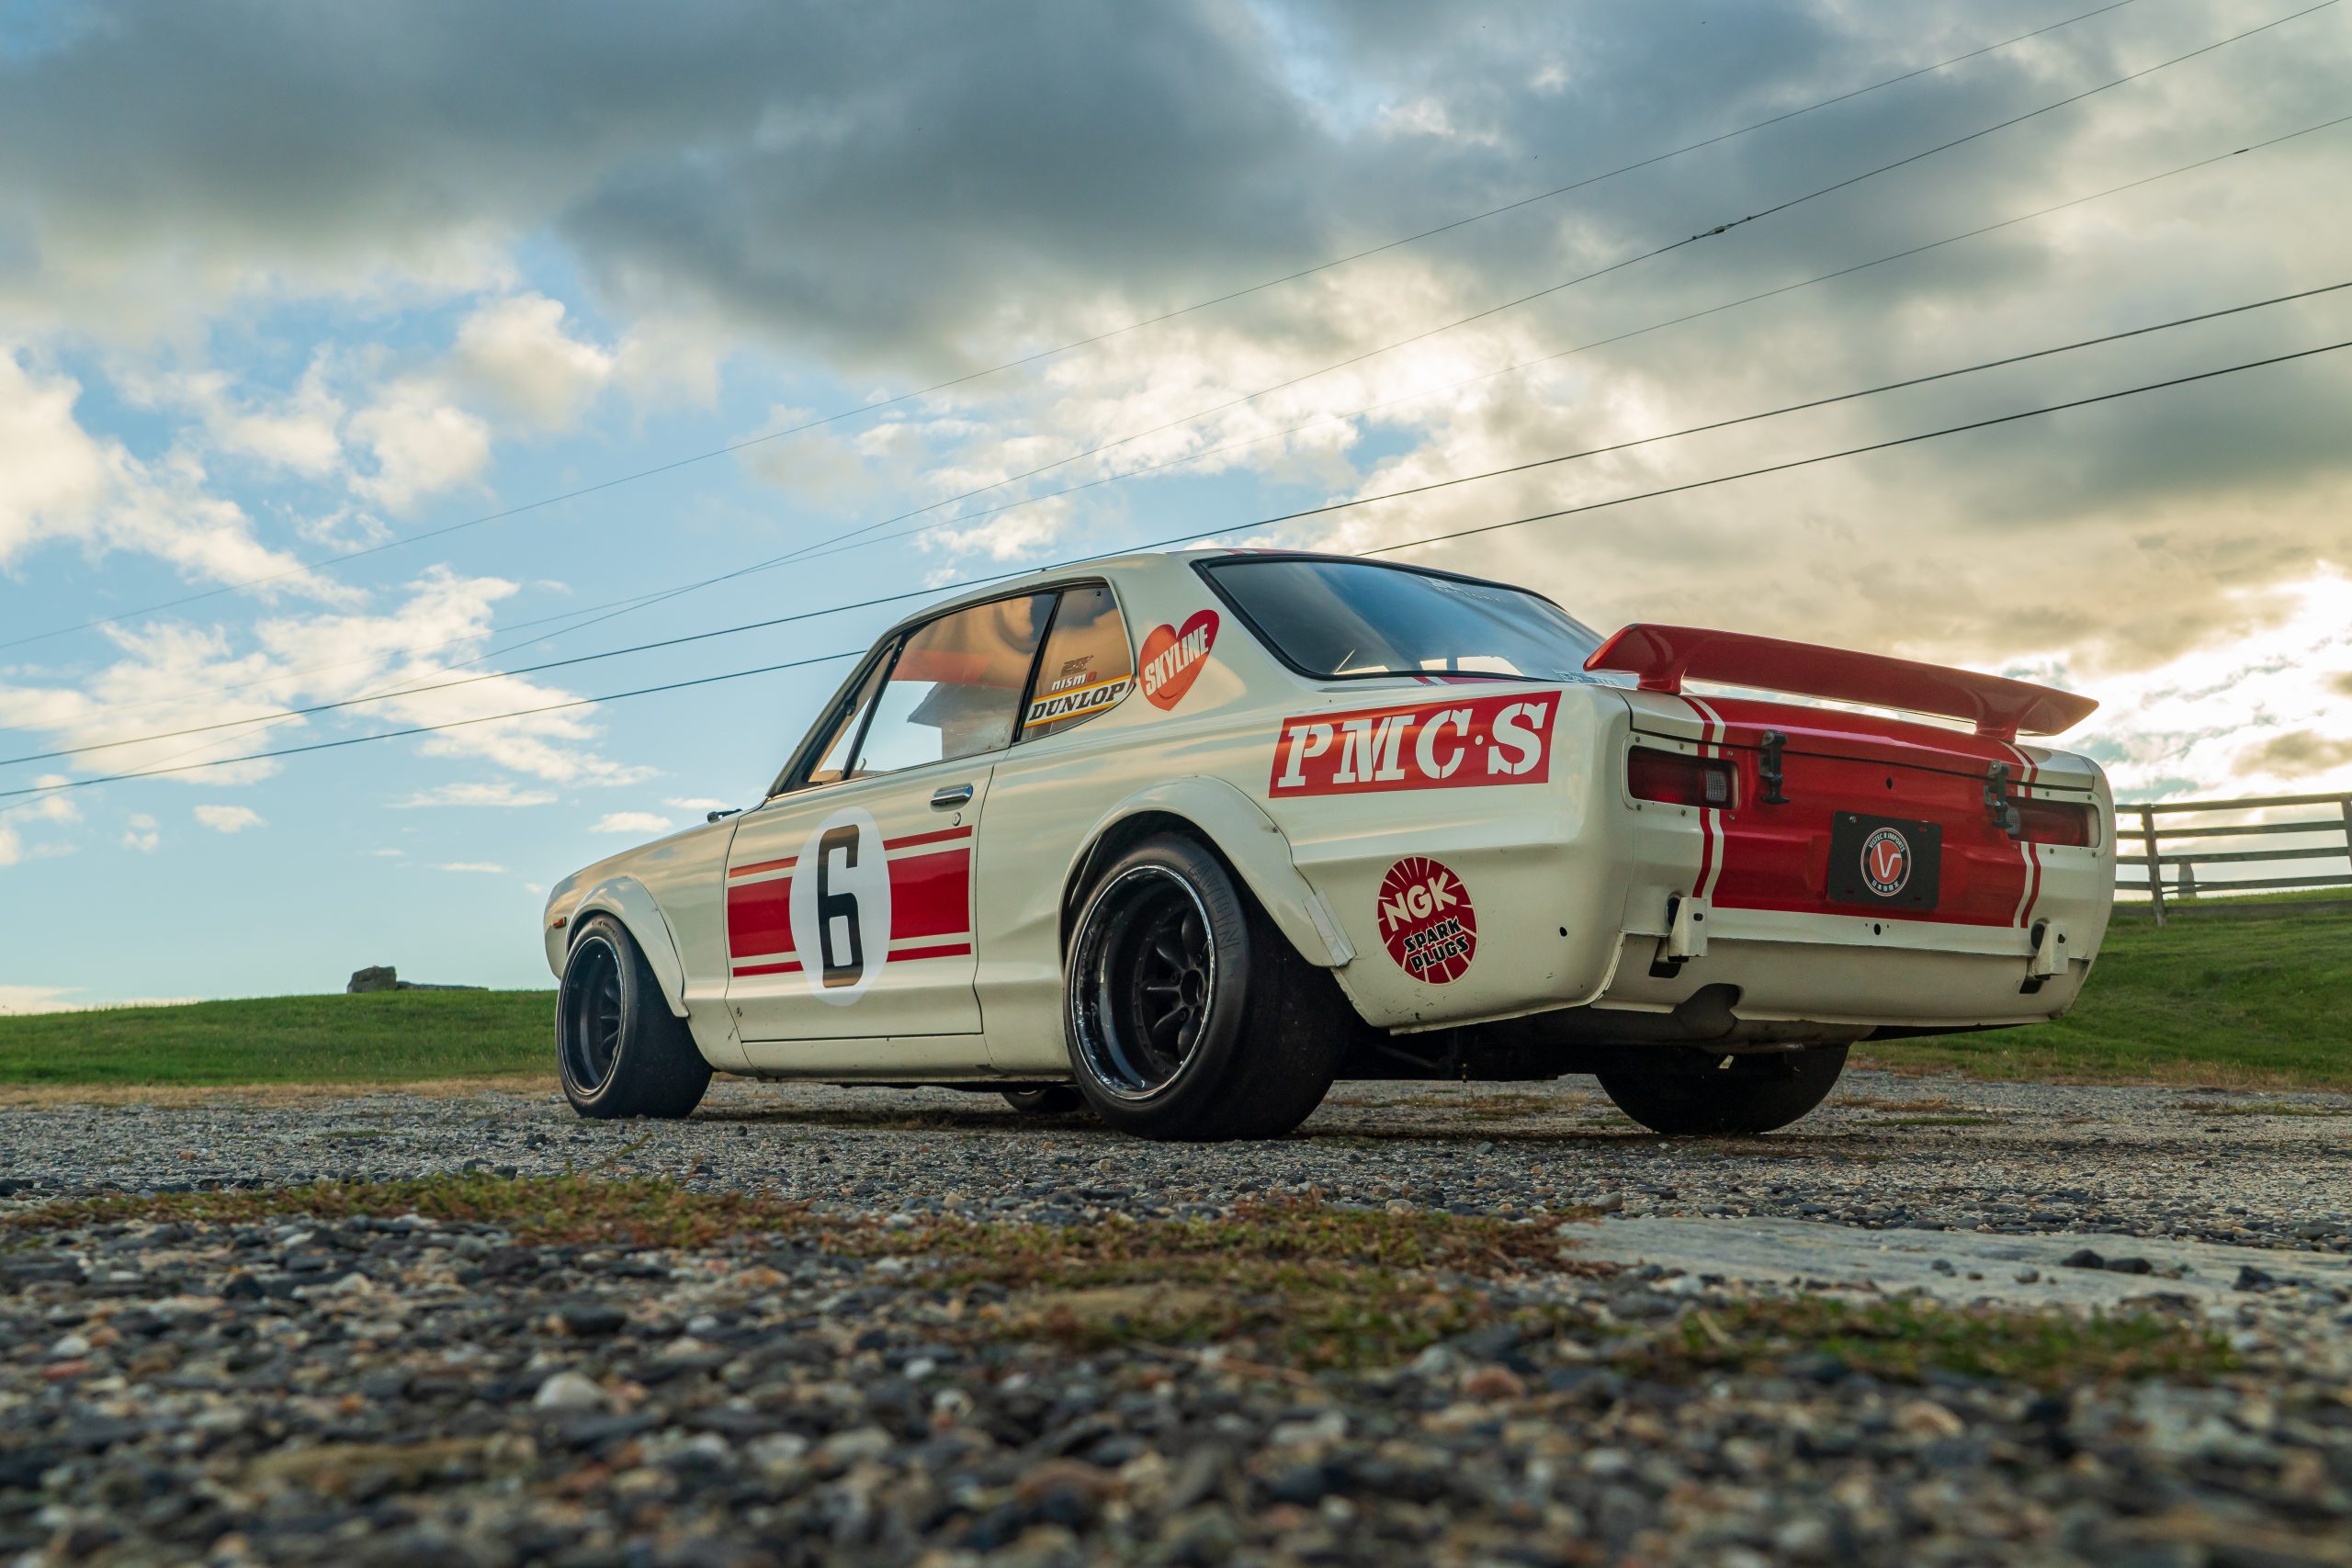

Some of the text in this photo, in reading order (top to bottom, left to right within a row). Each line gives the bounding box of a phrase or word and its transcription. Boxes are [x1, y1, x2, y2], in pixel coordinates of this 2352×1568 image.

[1144, 623, 1209, 696] SKYLINE
[1051, 671, 1097, 692] nismo
[1028, 682, 1126, 721] DUNLOP
[817, 823, 865, 988] 6
[1382, 871, 1458, 932] NGK
[1403, 916, 1463, 953] SPARK
[1409, 934, 1470, 973] PLUGS
